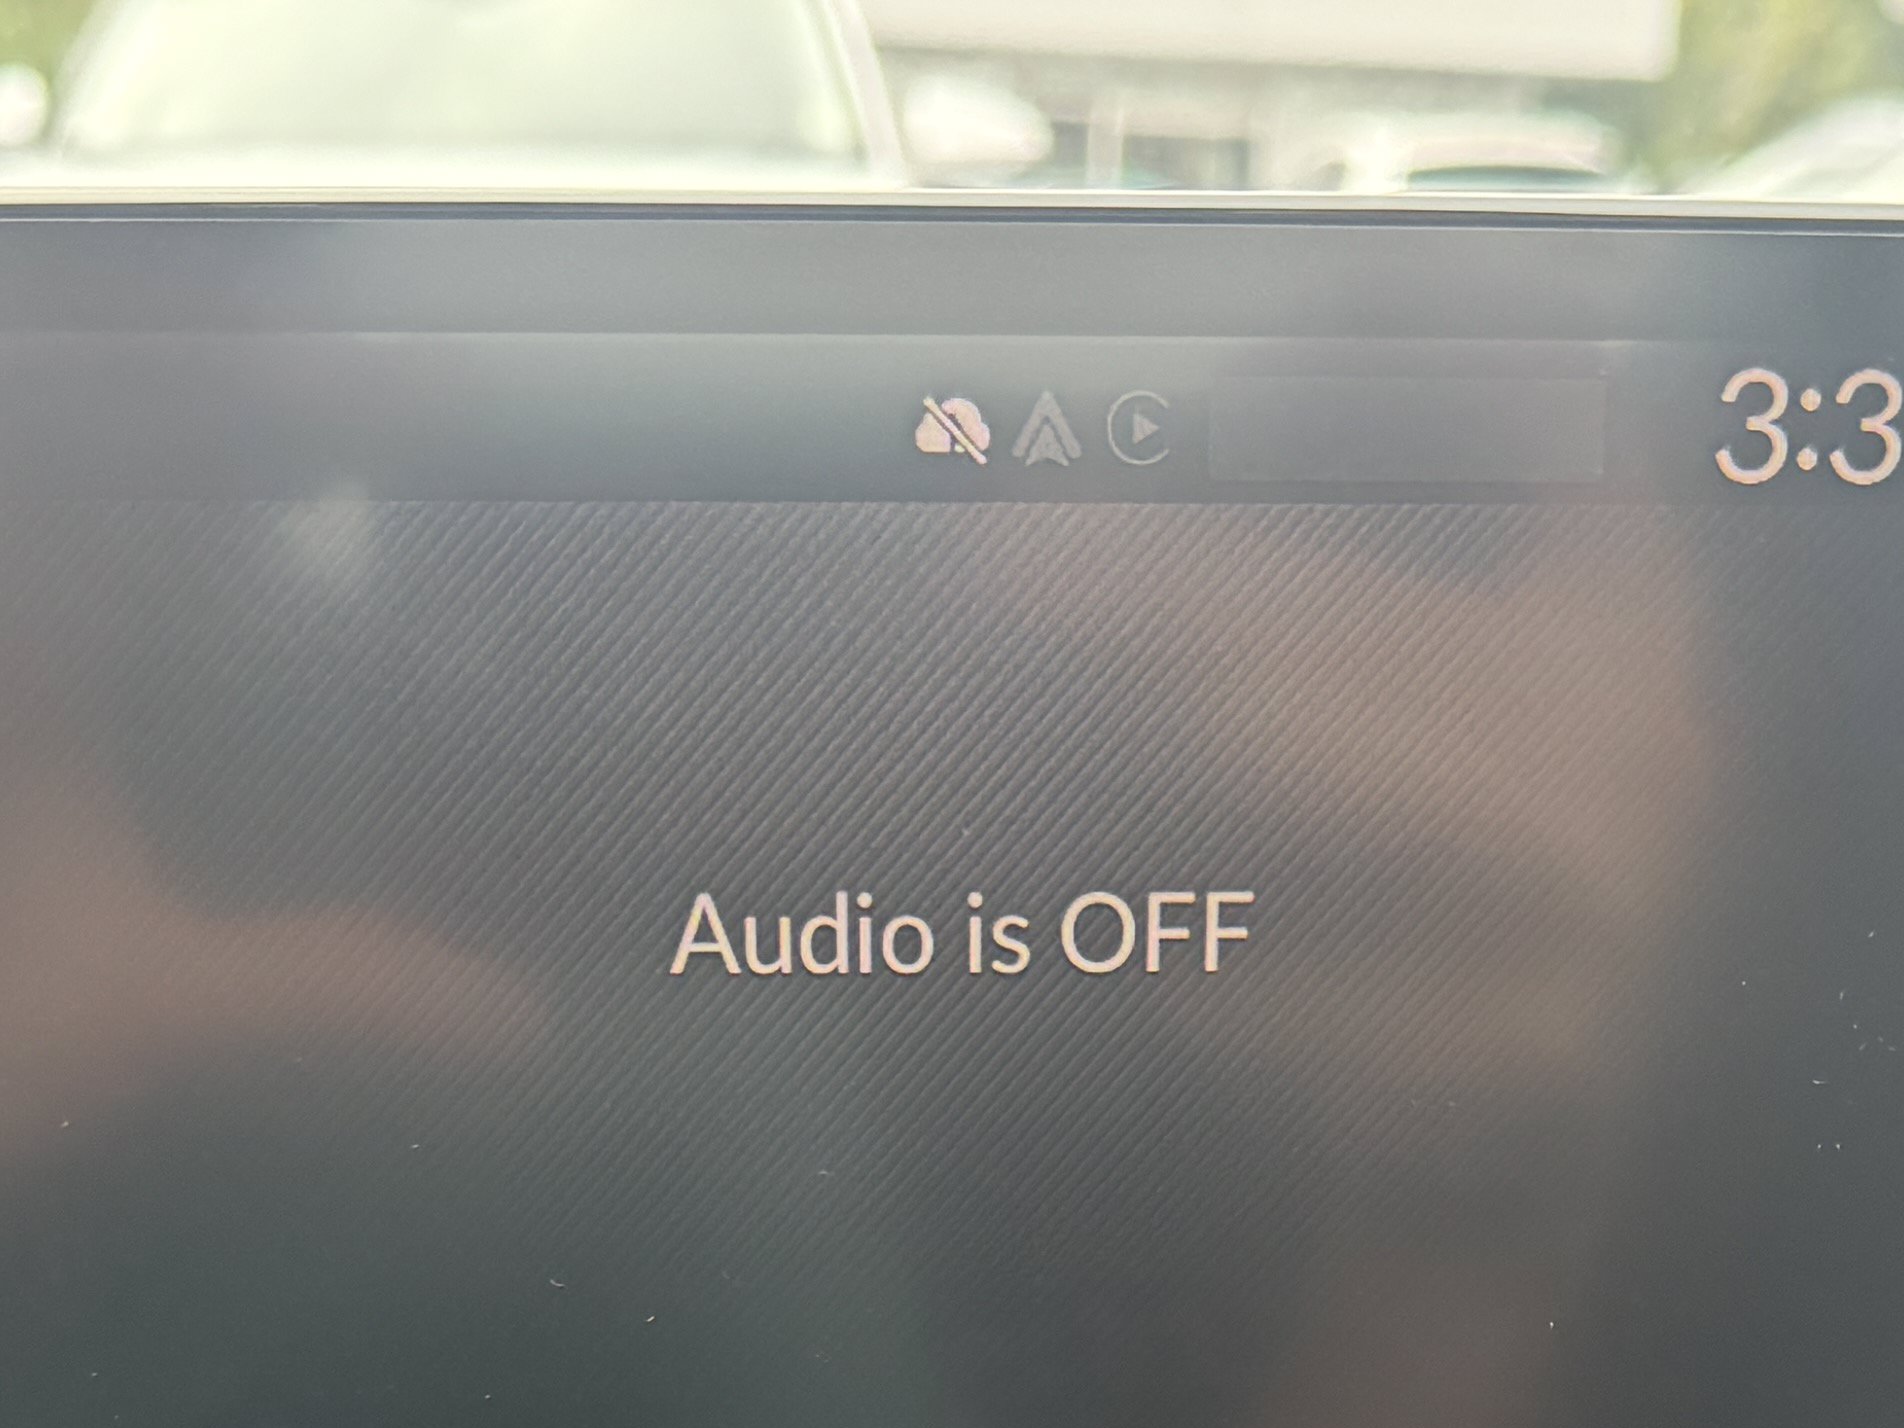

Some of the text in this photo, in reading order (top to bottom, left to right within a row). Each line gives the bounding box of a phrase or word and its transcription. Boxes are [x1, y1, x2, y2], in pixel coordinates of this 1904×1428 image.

[669, 890, 1257, 976] Audio is OFF
